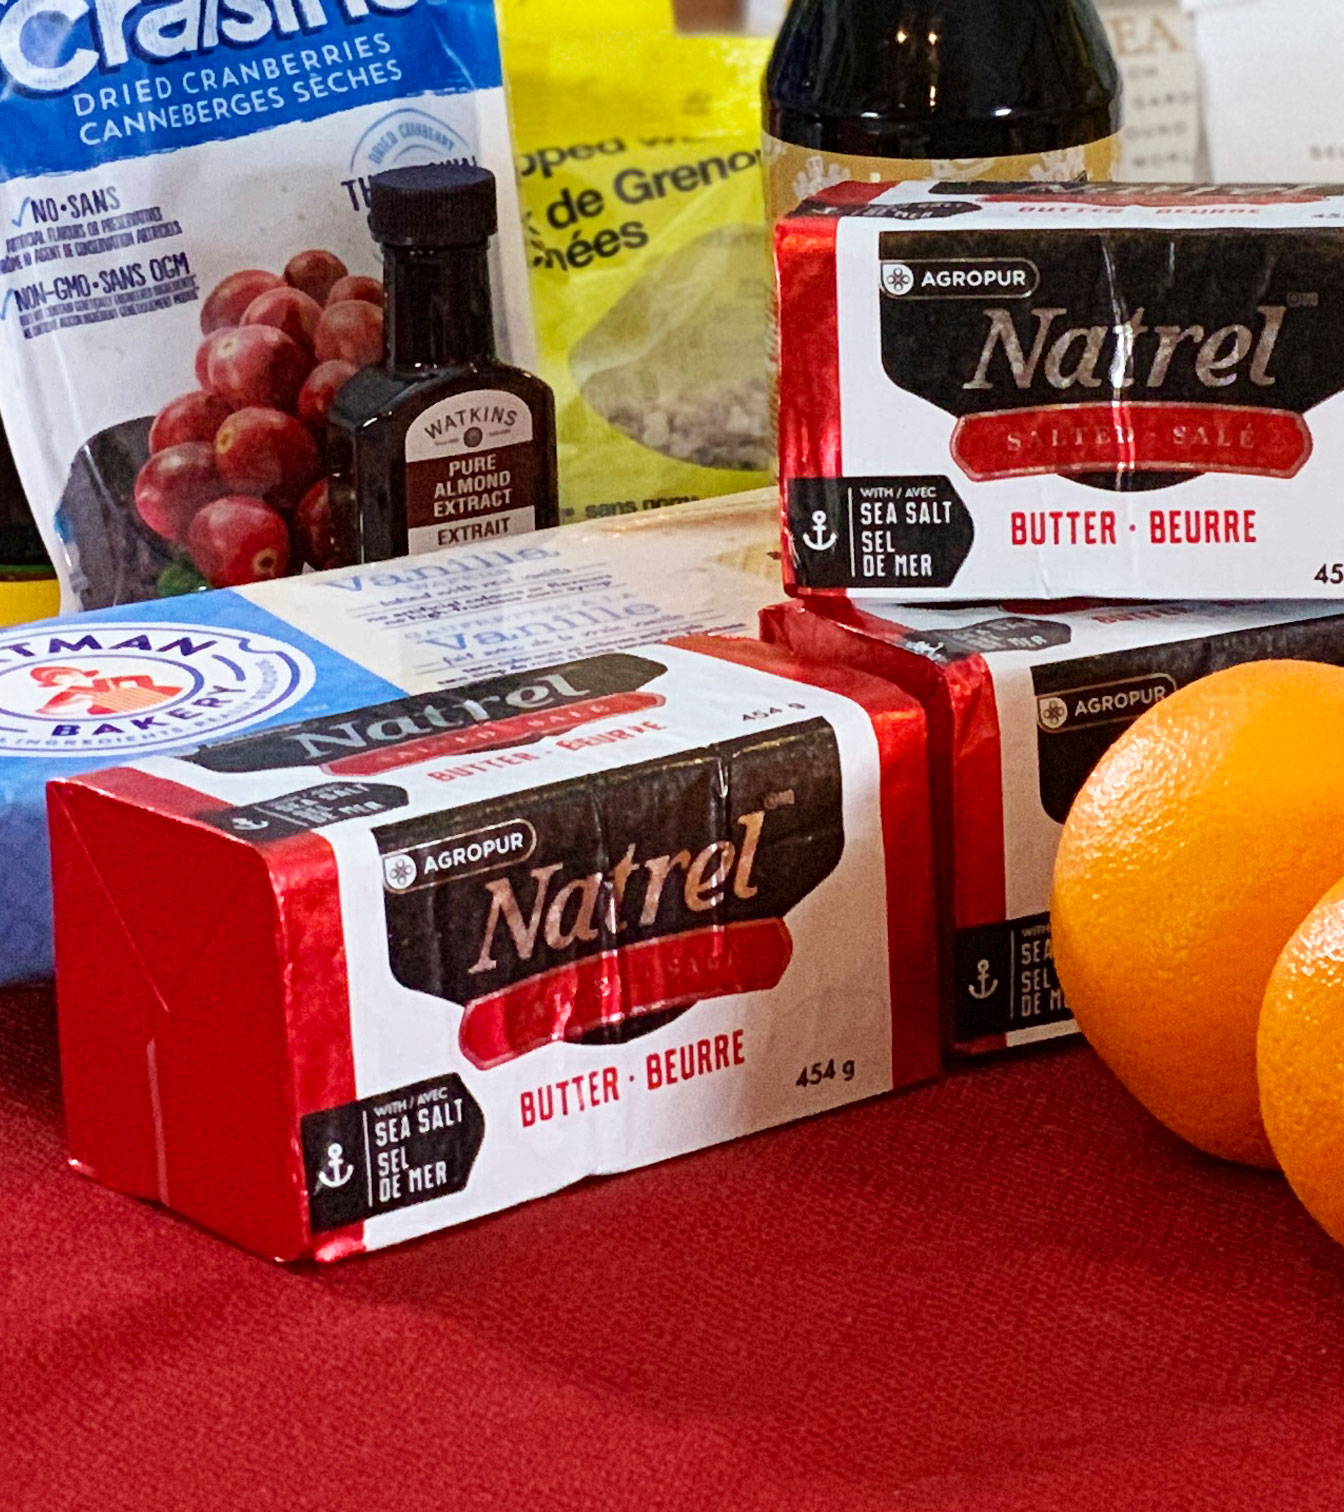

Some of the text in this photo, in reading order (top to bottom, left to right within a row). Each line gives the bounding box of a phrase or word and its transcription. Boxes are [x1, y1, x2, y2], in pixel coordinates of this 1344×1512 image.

[73, 33, 392, 116] DRIED CRANBERRIES
[79, 58, 403, 146] CANNEBERGES SÈCHES
[546, 148, 761, 231] de Greno
[921, 269, 1027, 289] AGROPUR
[963, 304, 1291, 390] Natrel
[424, 406, 517, 440] WATKINS
[1172, 419, 1256, 451] SALÉ
[449, 453, 497, 477] PURE
[433, 470, 511, 499] ALMOND
[905, 487, 937, 498] AVEC
[433, 489, 512, 518] EXTRACT
[861, 501, 952, 525] SEA SALT
[437, 517, 511, 546] EXTRAIT
[861, 532, 896, 554] SEL
[1010, 509, 1258, 546] BUTTER BEURRE
[861, 555, 932, 579] DE MER
[0, 633, 218, 663] TMAN
[51, 684, 246, 738] BAKERY
[288, 673, 592, 760] Natrel
[1074, 685, 1168, 718] AGROPUR
[427, 750, 539, 783] BUTTER
[556, 720, 668, 752] BEURRE
[423, 830, 525, 876] AGROPUR
[466, 810, 767, 976] Natrel
[1021, 938, 1053, 965] SEA
[1021, 968, 1052, 993] SEL
[1021, 992, 1042, 1017] DE
[520, 1029, 746, 1129] BUTTER BEURRE
[795, 1058, 857, 1088] 454 g
[415, 1087, 449, 1107] AVEC
[374, 1097, 465, 1147] SEA SALT
[377, 1146, 410, 1178] SEL
[377, 1160, 448, 1203] DE MER
